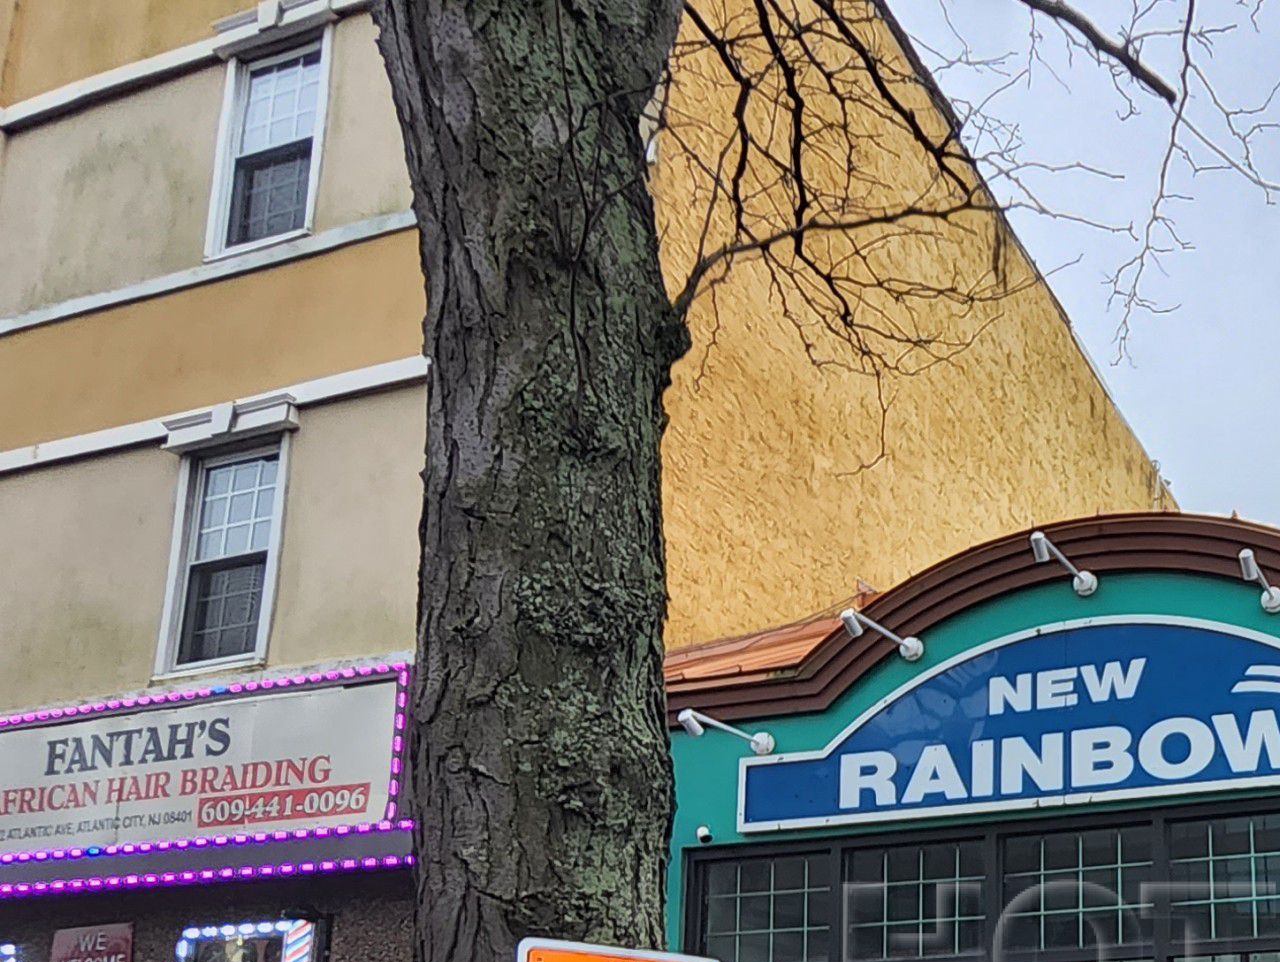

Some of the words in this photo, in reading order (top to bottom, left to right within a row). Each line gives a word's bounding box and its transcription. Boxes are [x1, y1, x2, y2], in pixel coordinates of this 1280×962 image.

[989, 658, 1146, 716] NEW
[45, 718, 231, 776] FANTAH'S
[105, 771, 170, 804] HAIR
[179, 755, 331, 797] BRAIDING
[148, 813, 162, 826] NJ
[201, 787, 366, 823] 609-441-0096
[79, 932, 108, 952] WE
